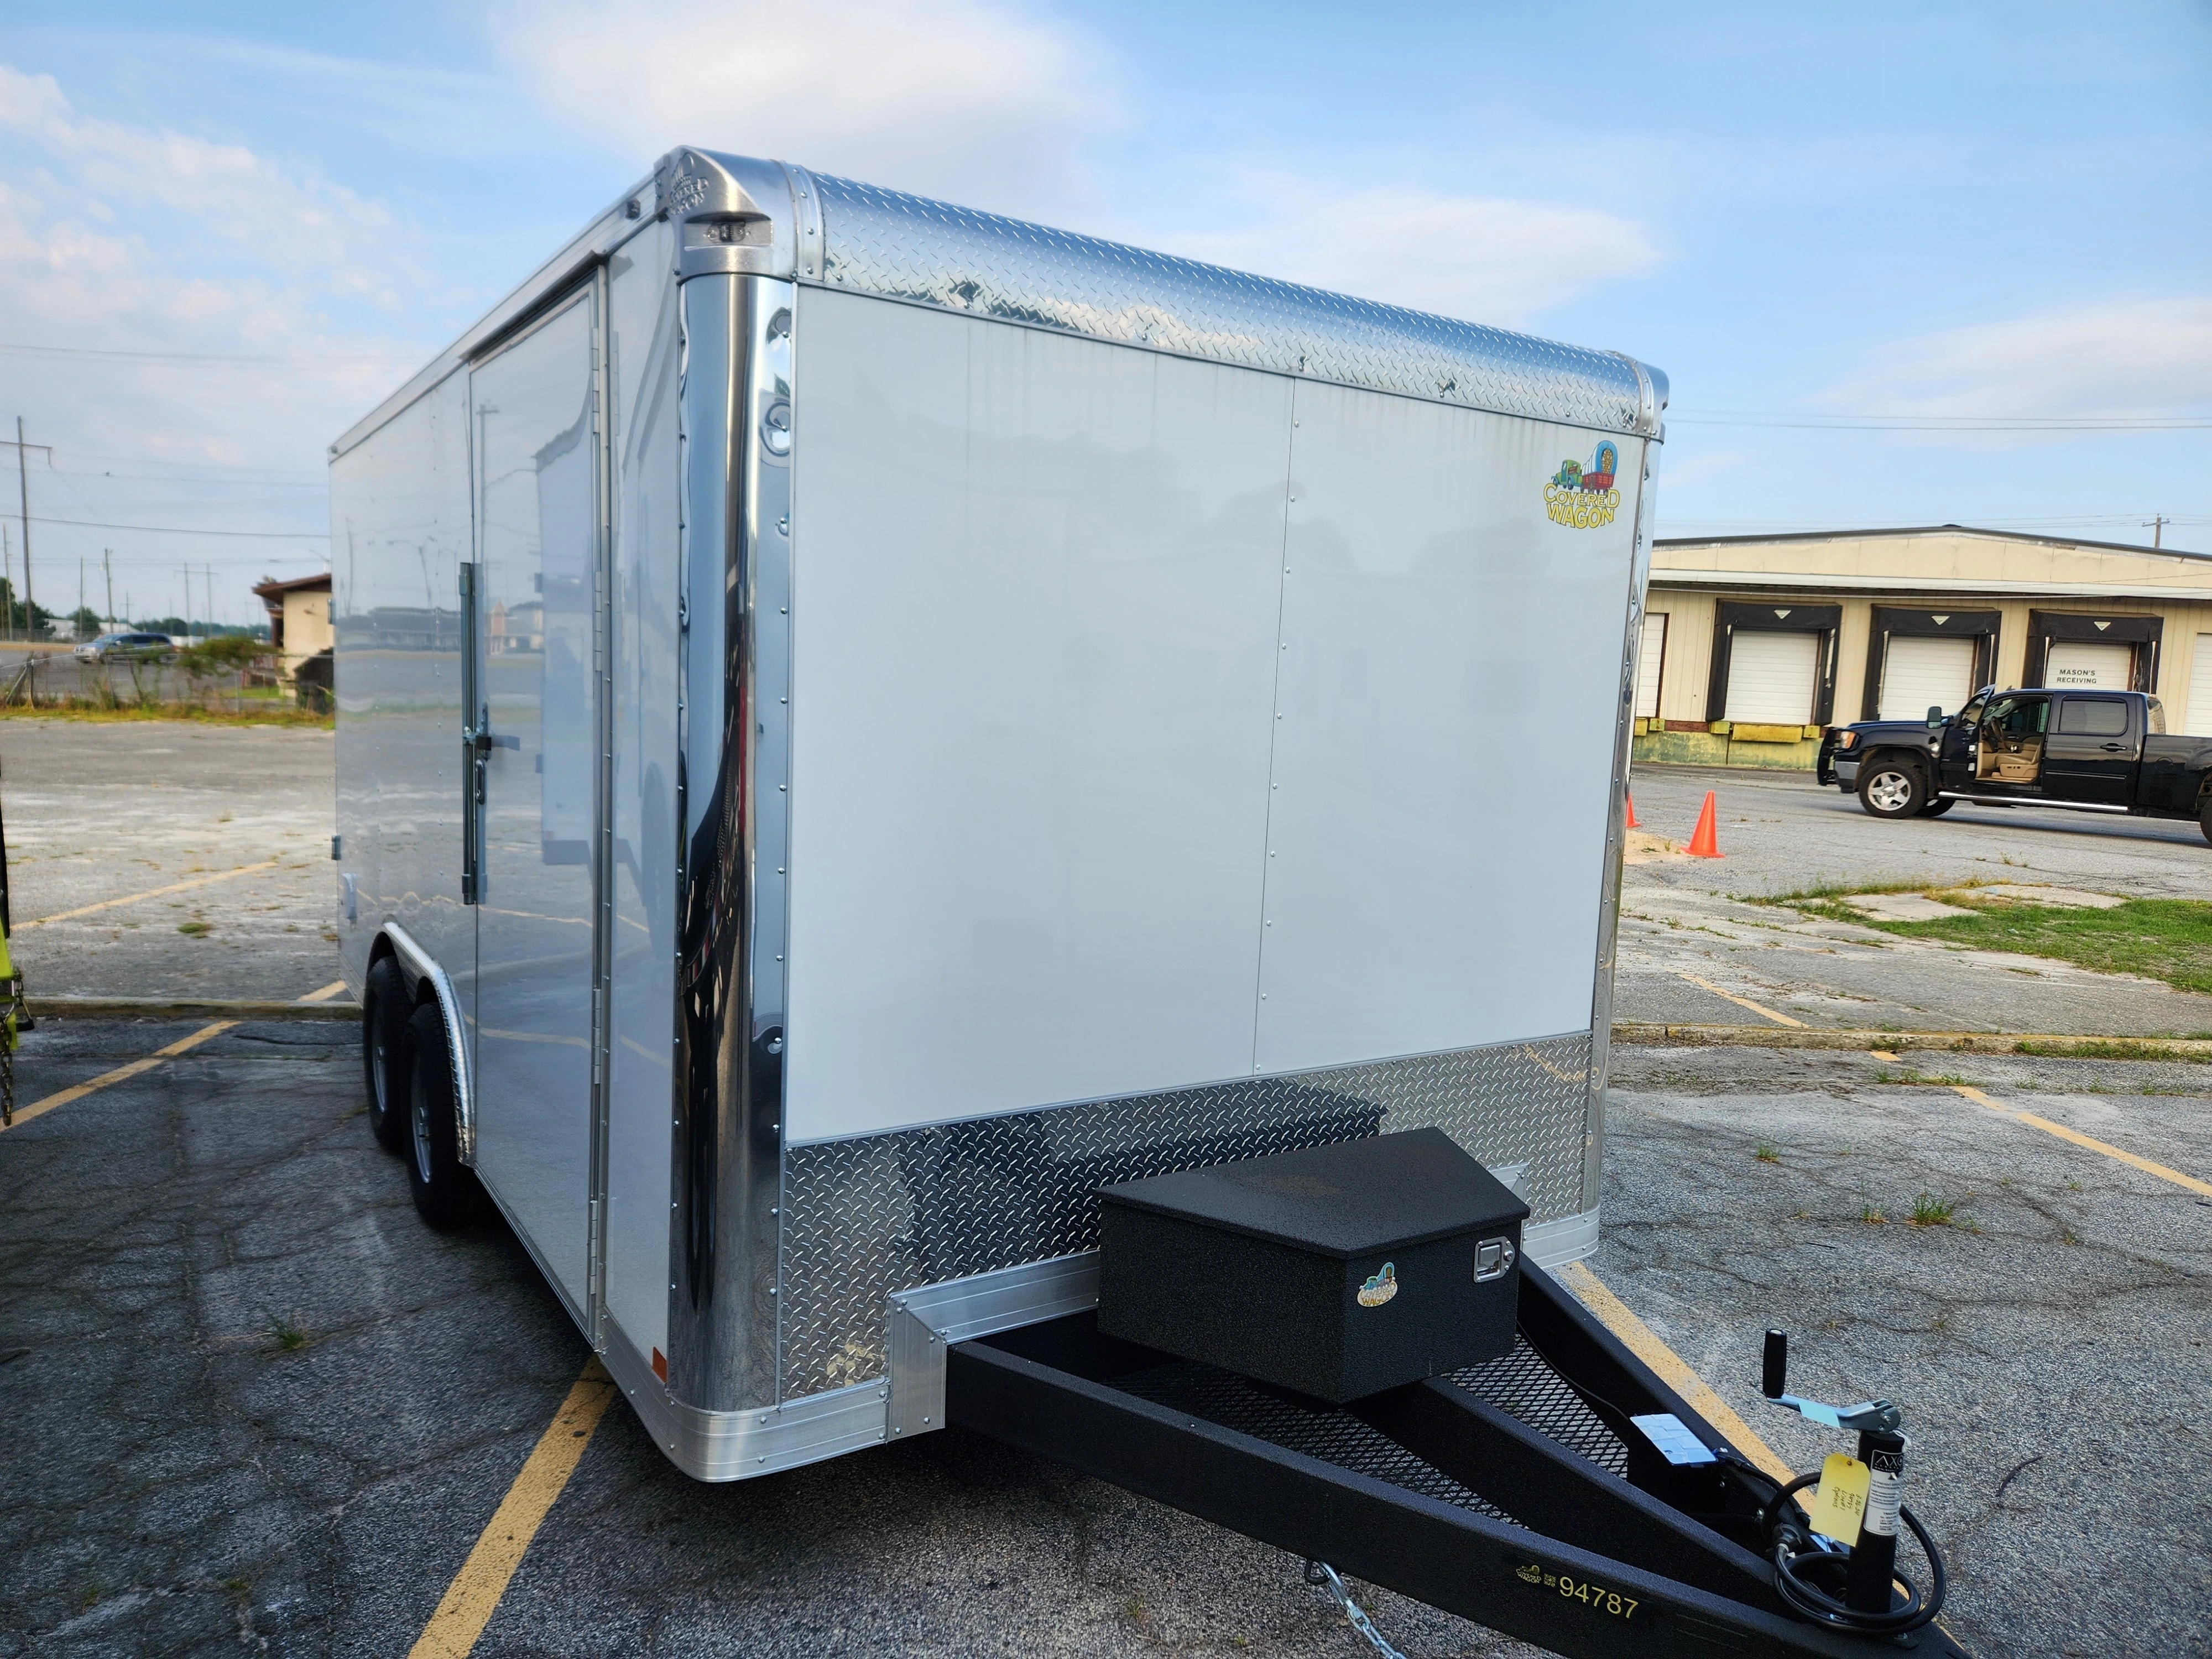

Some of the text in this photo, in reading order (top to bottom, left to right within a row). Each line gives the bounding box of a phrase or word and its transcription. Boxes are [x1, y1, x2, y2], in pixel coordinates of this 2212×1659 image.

[1543, 483, 1620, 509] COVERED
[1546, 503, 1615, 529] WAGON
[1360, 1282, 1396, 1299] COVERED
[1361, 1290, 1394, 1306] WAGON
[1517, 1572, 1540, 1584] WAGON
[1559, 1576, 1639, 1619] 94787
